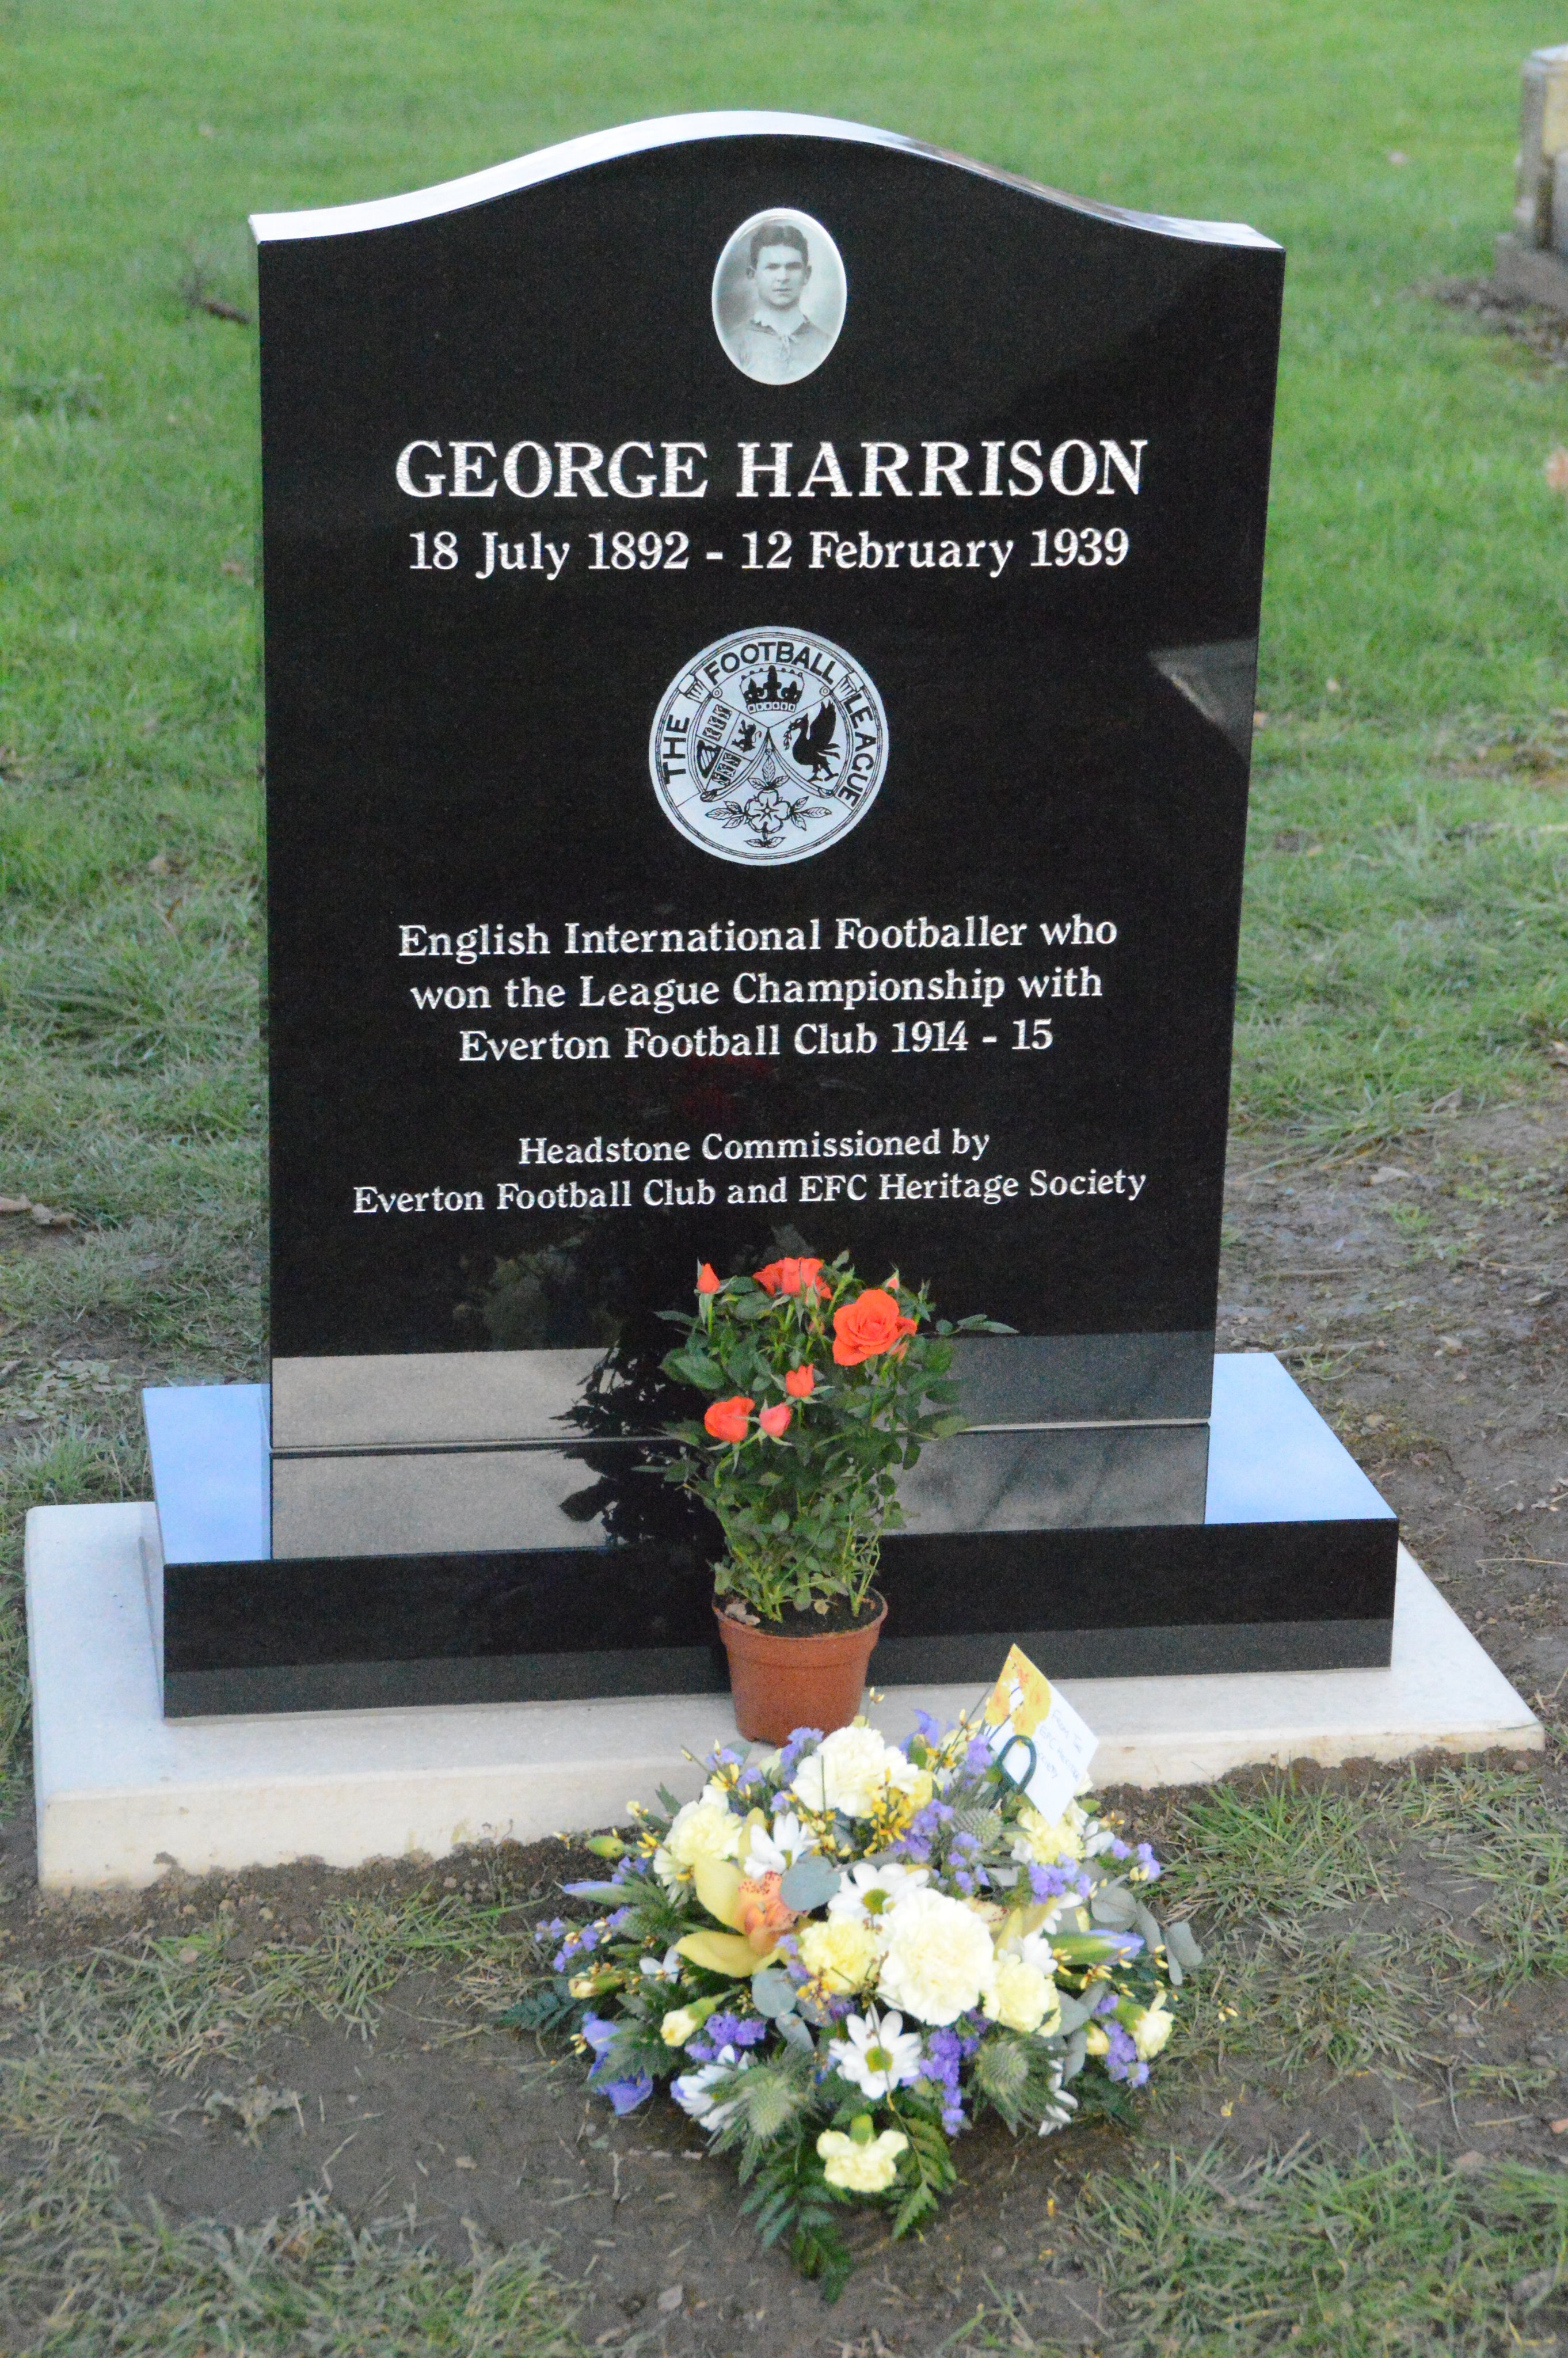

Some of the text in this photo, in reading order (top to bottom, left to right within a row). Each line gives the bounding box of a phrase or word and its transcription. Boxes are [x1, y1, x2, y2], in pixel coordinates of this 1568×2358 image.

[395, 439, 1148, 499] GEORGE HARRISON
[409, 527, 1129, 581] 18 July 1892 - 12 February 1939
[661, 641, 877, 807] THE FOOTBALL LEAGUE
[398, 913, 1117, 965] English International Footballer who
[410, 965, 1103, 1014] won the League Championship with
[459, 1030, 611, 1062] Everton
[624, 1024, 781, 1058] Football
[794, 1022, 877, 1055] Club
[891, 1020, 969, 1053] 1914
[1011, 1018, 1053, 1050] 15
[518, 1127, 990, 1165] Headstone Commissioned by
[353, 1168, 1146, 1214] Everton Football Club and EFC Heritage Society
